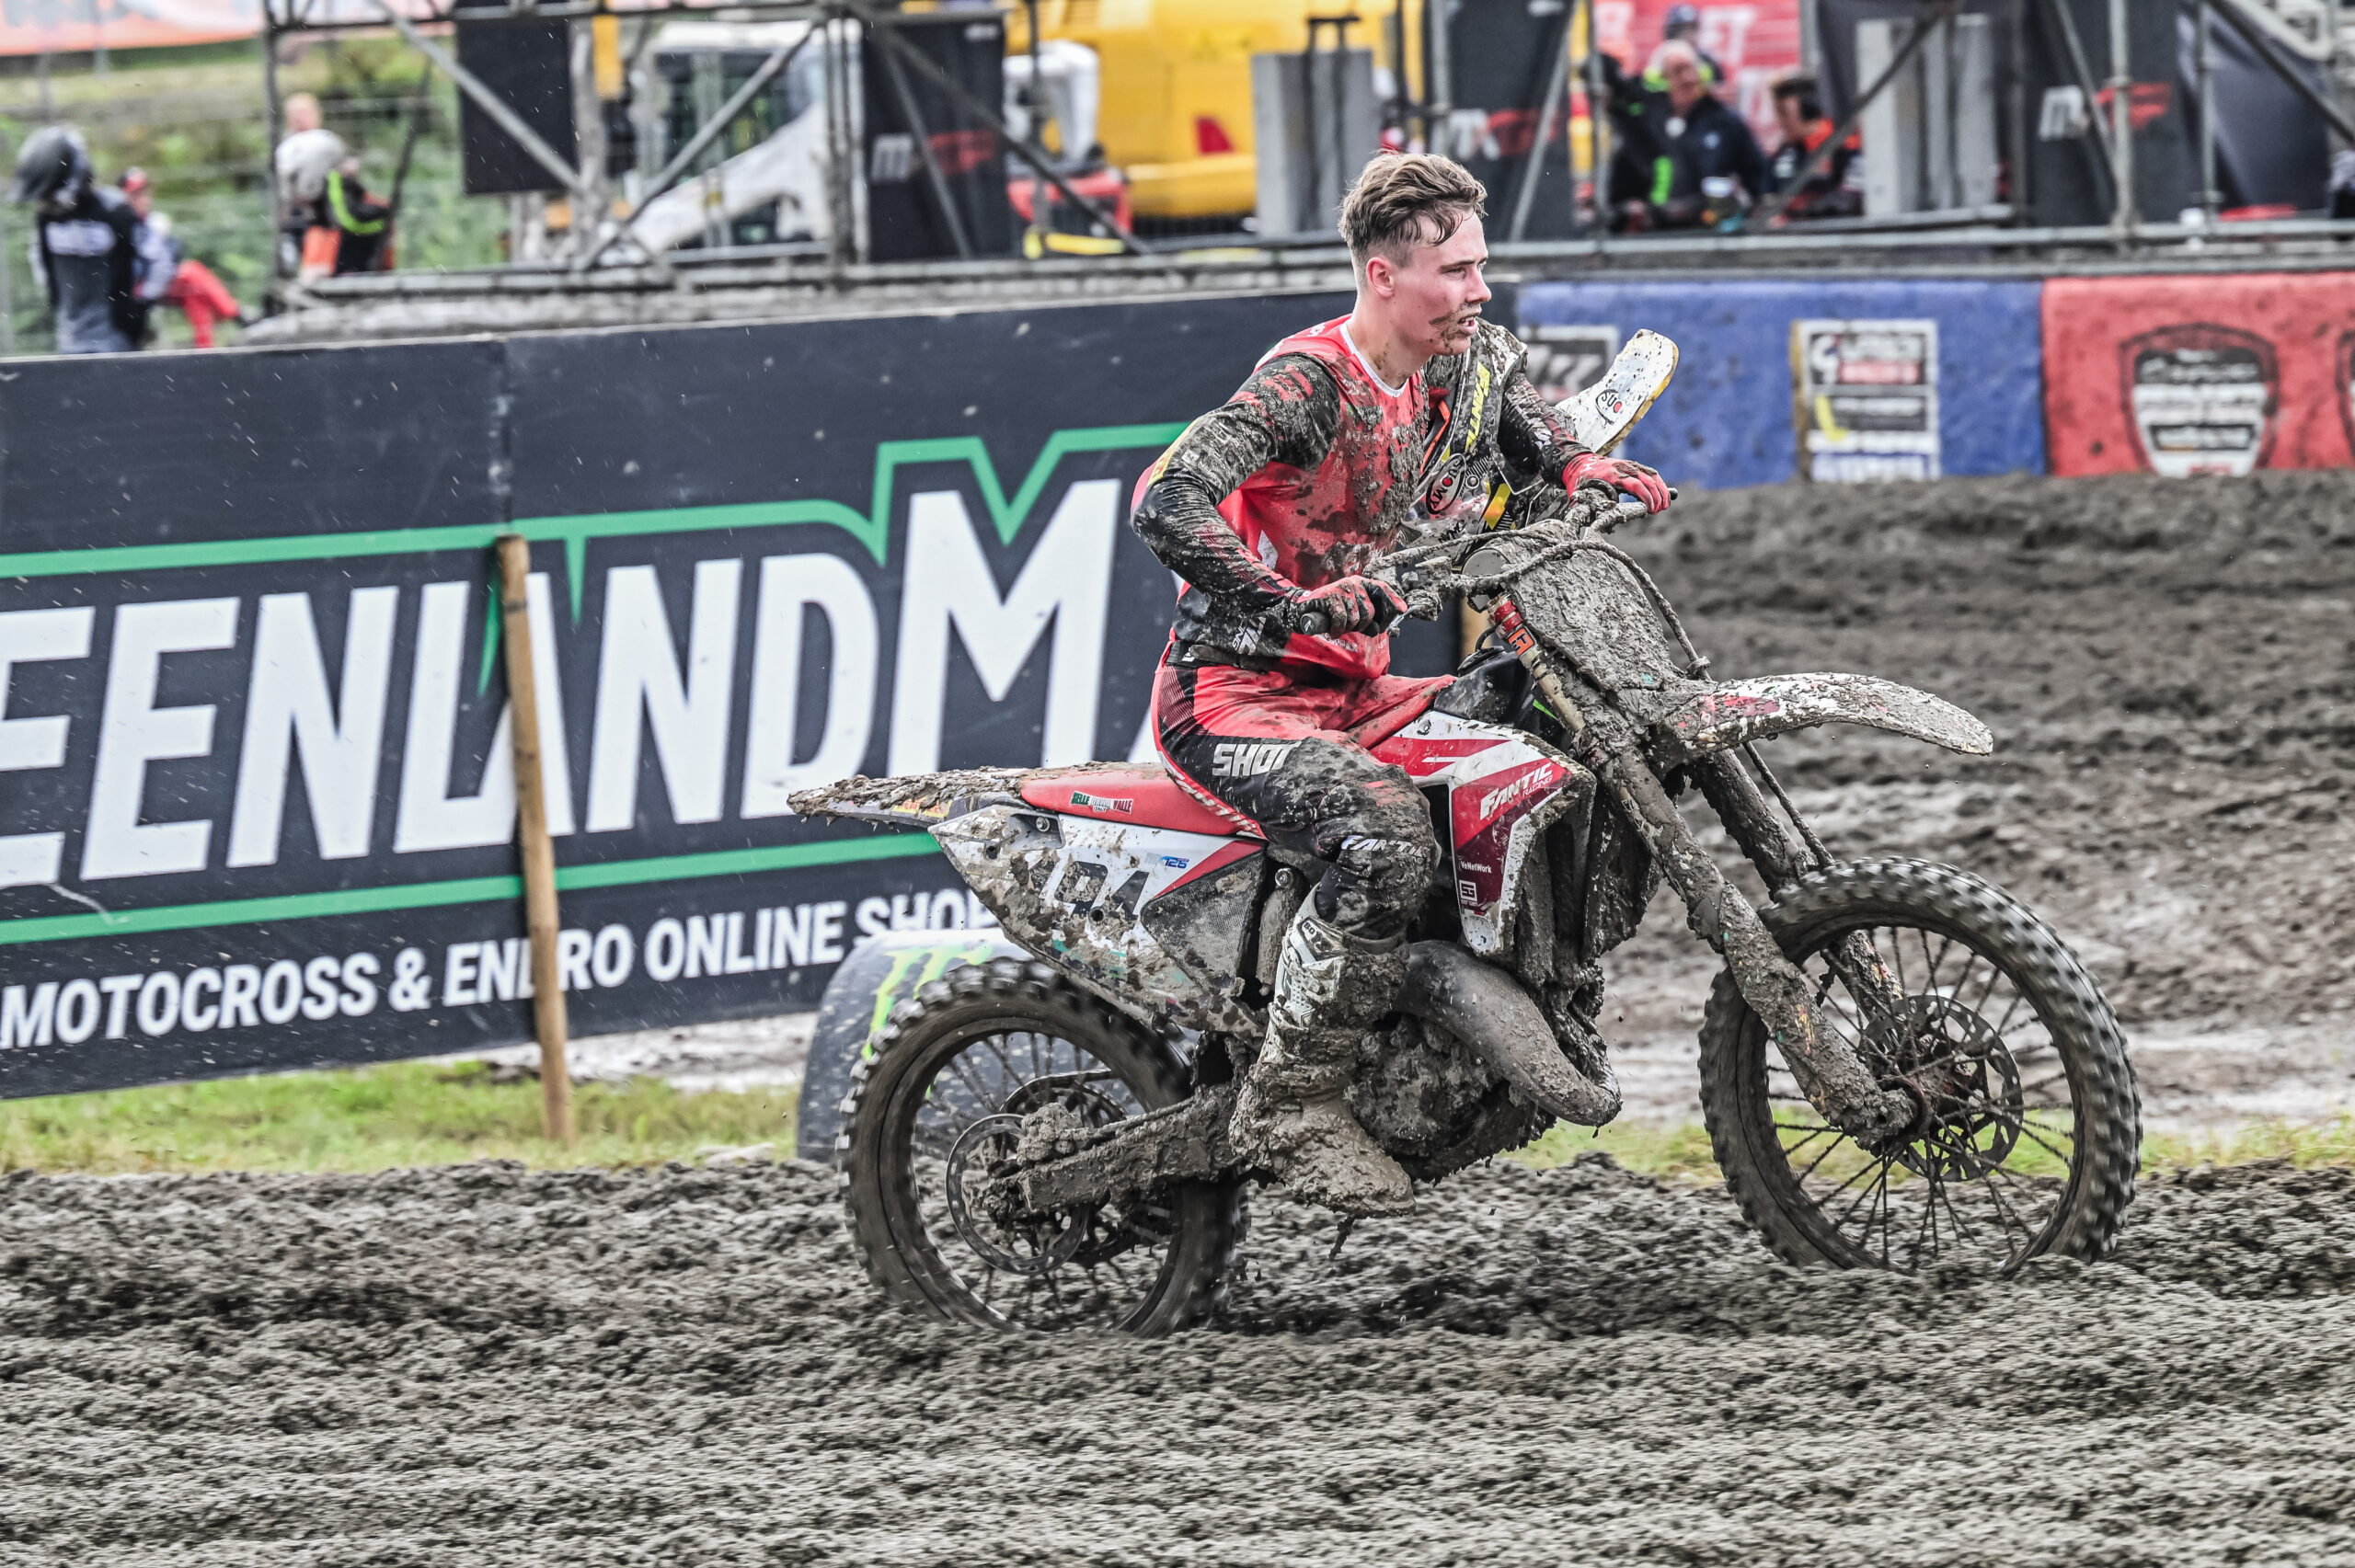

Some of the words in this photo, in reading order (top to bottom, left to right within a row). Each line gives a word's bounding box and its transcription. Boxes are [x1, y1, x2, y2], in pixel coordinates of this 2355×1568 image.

[1601, 390, 1623, 414] SUO
[1429, 459, 1464, 509] SUOMY
[0, 478, 1165, 887] EENLANDM
[1479, 761, 1553, 821] FANTIC
[1522, 774, 1553, 797] RACING
[0, 952, 381, 1050] MOTOCROSS
[388, 946, 431, 1012] &
[442, 922, 636, 1008] ENRO
[648, 900, 848, 982] ONLINE
